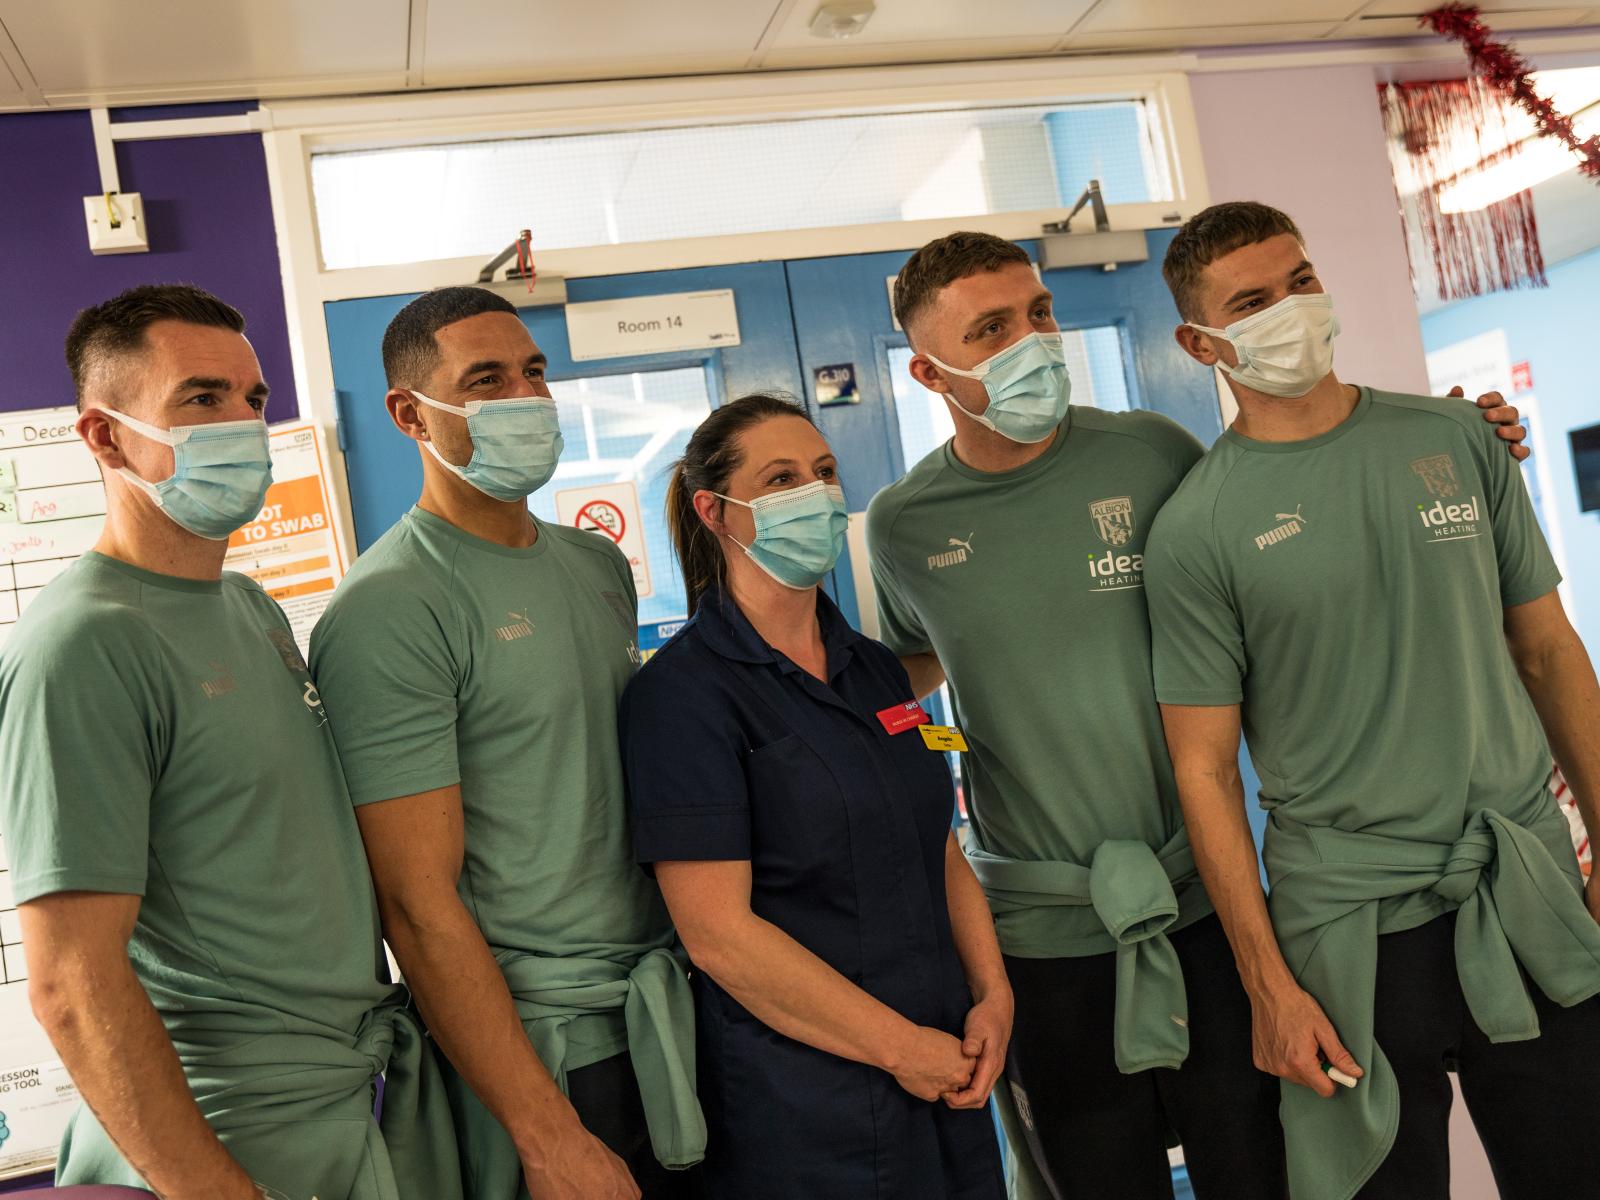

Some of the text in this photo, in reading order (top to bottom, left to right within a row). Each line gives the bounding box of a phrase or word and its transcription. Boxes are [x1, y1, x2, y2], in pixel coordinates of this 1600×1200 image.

[617, 315, 683, 334] Room 14
[254, 504, 283, 524] OT
[1093, 503, 1130, 516] ALBION
[1418, 495, 1480, 528] ideal
[240, 512, 325, 542] TO SWAB
[1254, 520, 1302, 551] PUMA
[1434, 524, 1477, 537] HEATING
[927, 548, 967, 570] PUMA
[1100, 574, 1144, 587] HEATIN
[905, 702, 919, 711] NHS
[0, 1068, 39, 1083] ESSION
[14, 1078, 43, 1090] TOOL
